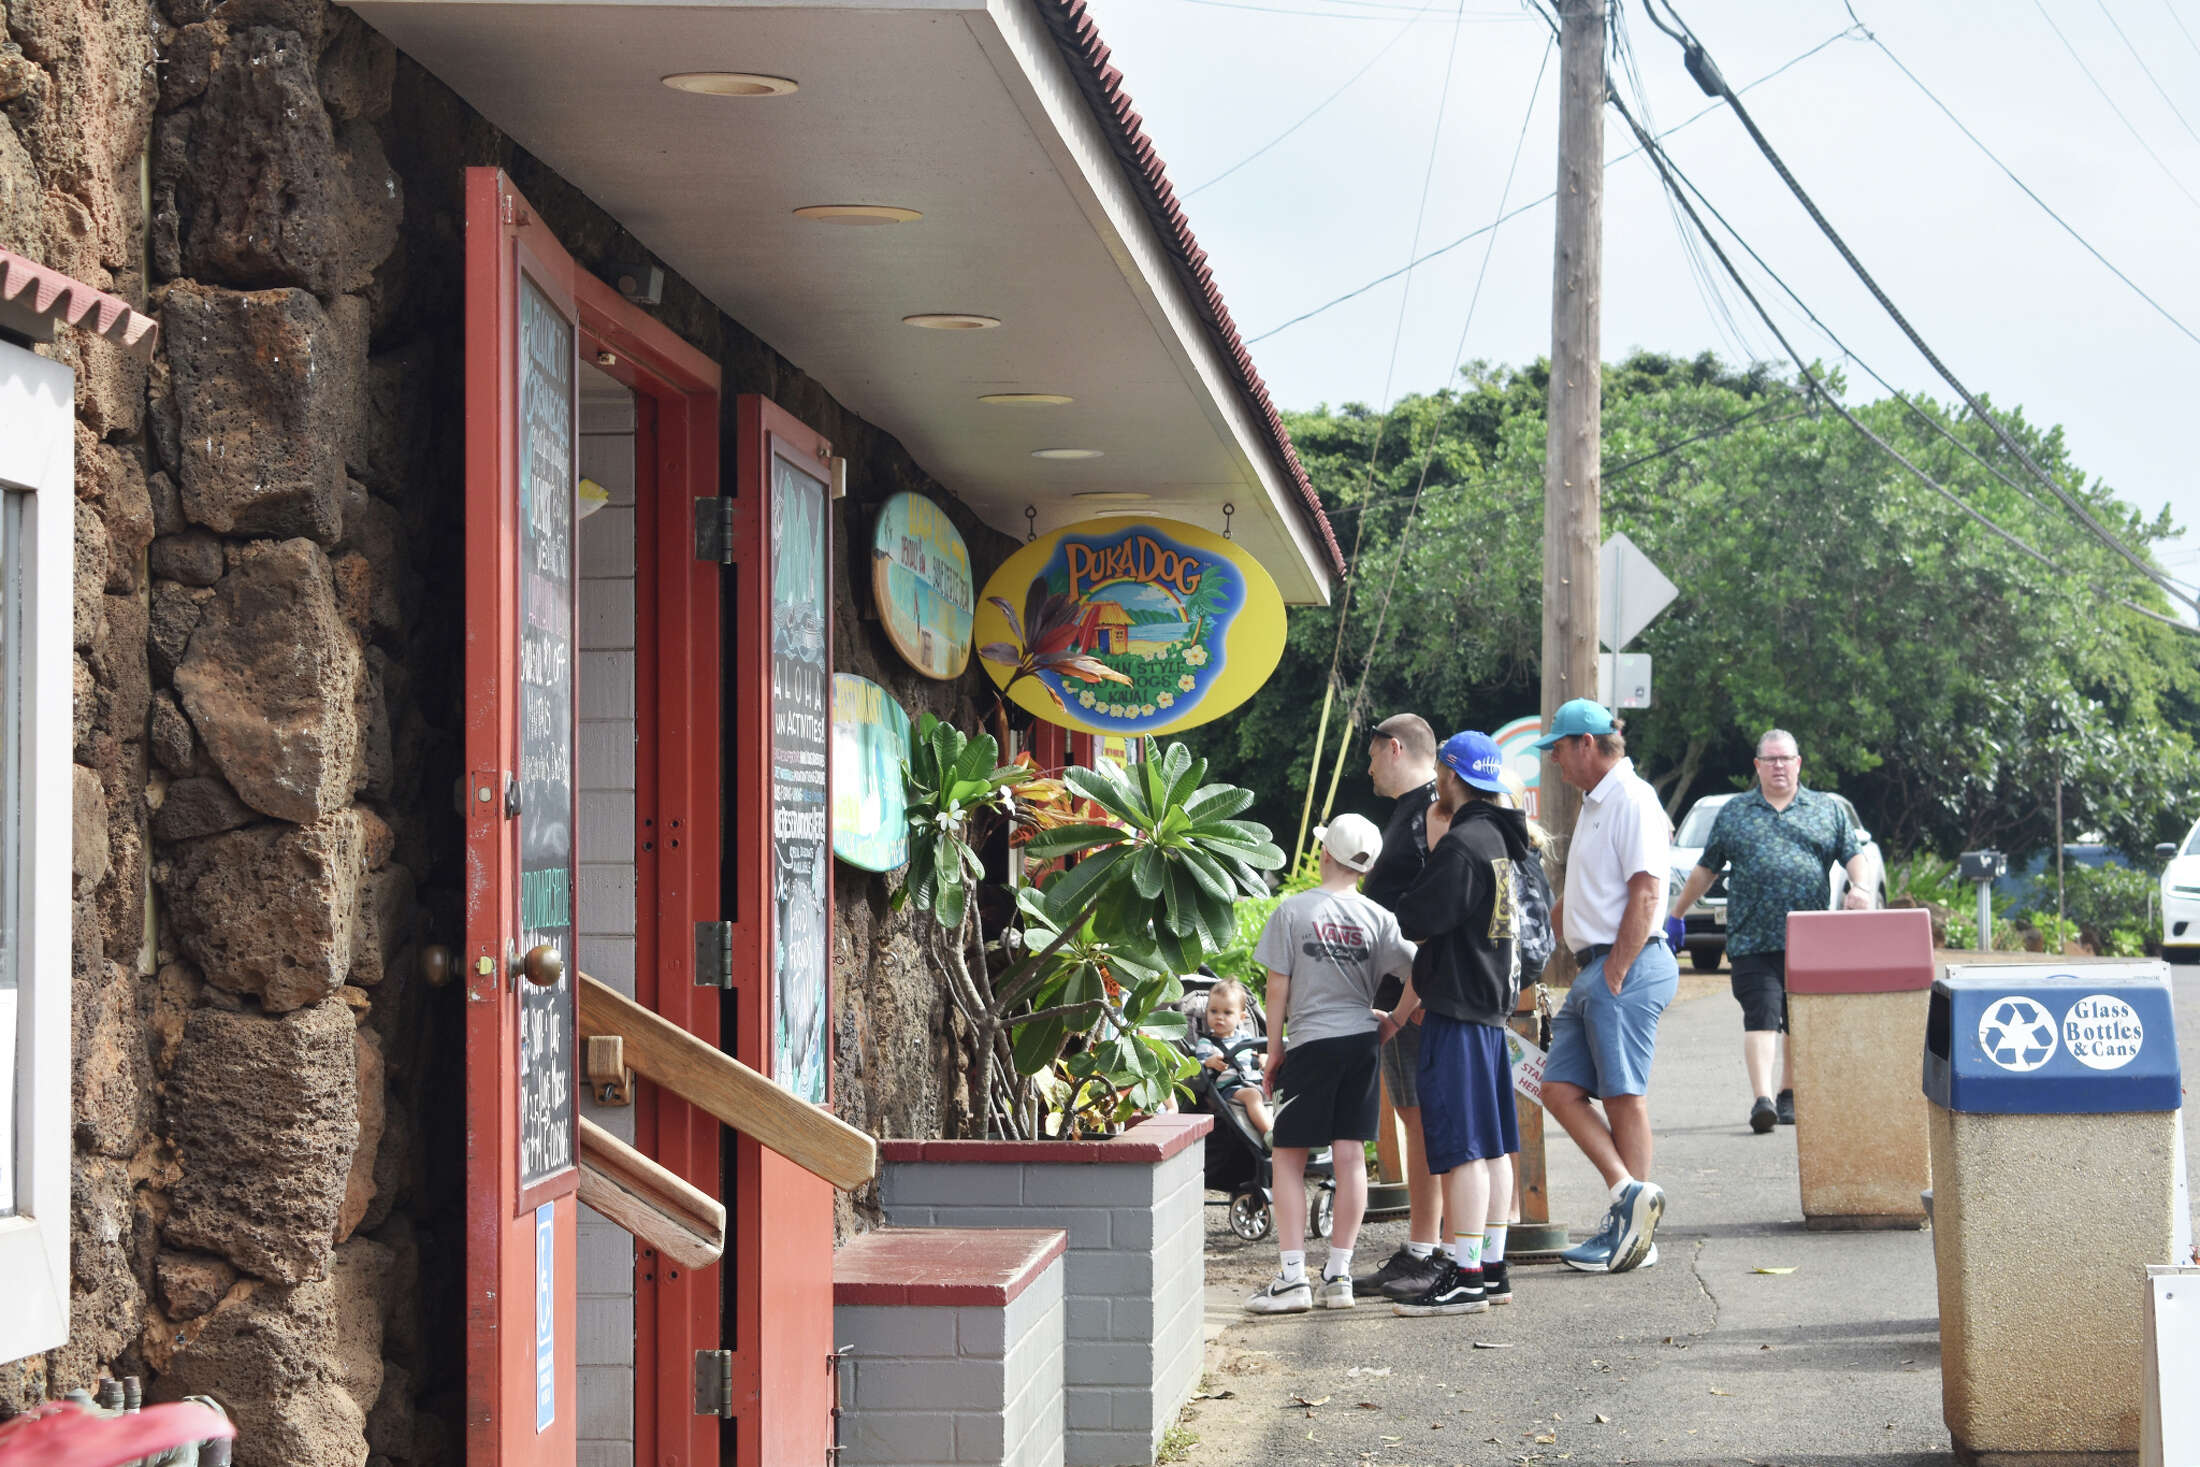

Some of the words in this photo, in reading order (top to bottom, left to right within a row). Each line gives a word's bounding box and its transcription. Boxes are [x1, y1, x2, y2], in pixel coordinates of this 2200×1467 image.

[1065, 537, 1138, 605] PUKA
[1135, 535, 1202, 595] DOG
[1137, 661, 1185, 674] STYLE
[775, 660, 822, 712] ALOHA
[1312, 921, 1364, 946] VANS
[2074, 1001, 2129, 1019] Glass
[2066, 1021, 2142, 1041] Bottles
[2073, 1041, 2088, 1057] &
[2091, 1041, 2136, 1057] Cans
[1535, 1055, 1548, 1068] LI
[1520, 1063, 1543, 1082] STA
